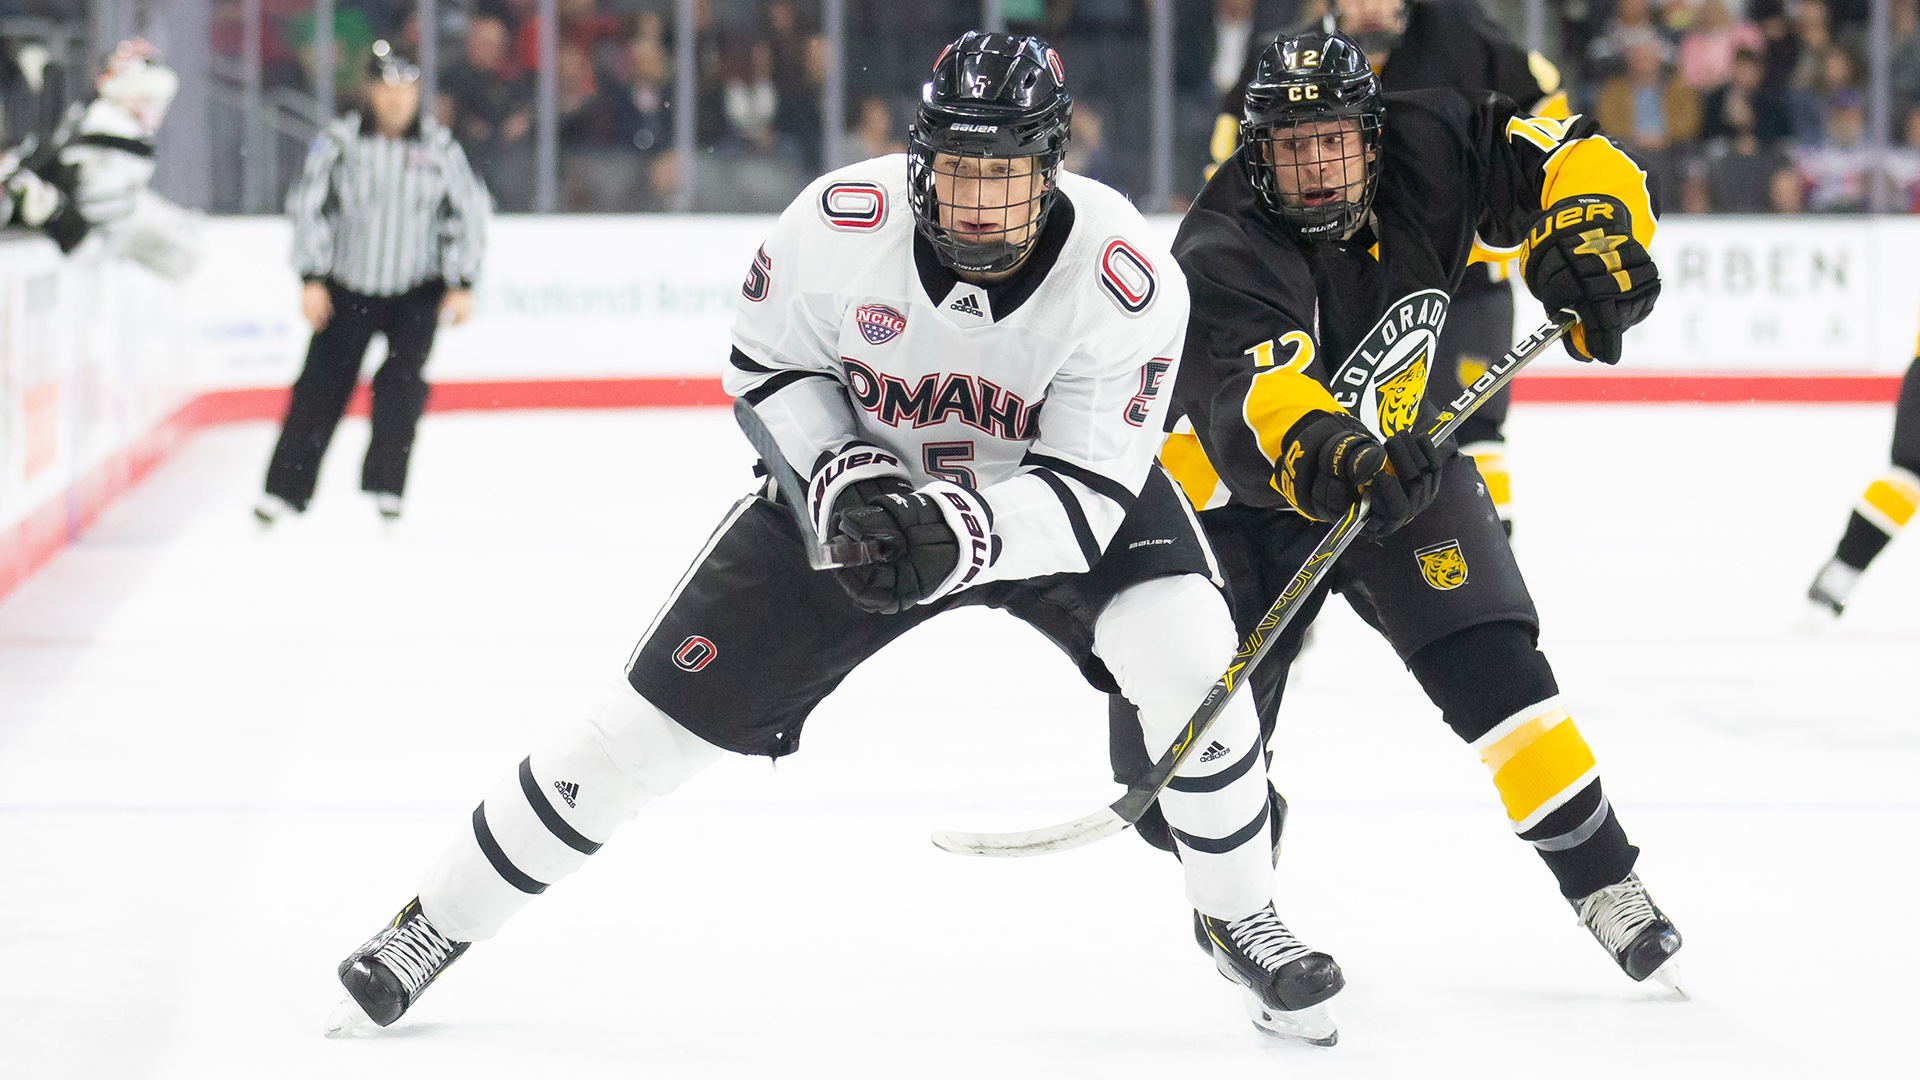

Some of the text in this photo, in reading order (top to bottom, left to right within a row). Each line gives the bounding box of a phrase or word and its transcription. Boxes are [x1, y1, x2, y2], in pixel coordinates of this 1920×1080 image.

[1288, 50, 1319, 70] 12
[971, 75, 988, 98] 5
[1288, 85, 1319, 102] CC
[950, 122, 998, 134] BAUER
[816, 180, 889, 234] O
[1095, 235, 1160, 319] O
[857, 309, 905, 332] NCHC
[950, 302, 984, 318] adidas
[1450, 318, 1560, 412] BAUER
[922, 441, 977, 490] 5
[812, 452, 899, 535] UER
[940, 491, 987, 592] BAU
[1129, 538, 1176, 549] BAUER
[672, 635, 718, 672] O
[1200, 747, 1231, 763] adidas
[554, 781, 576, 809] adidas
